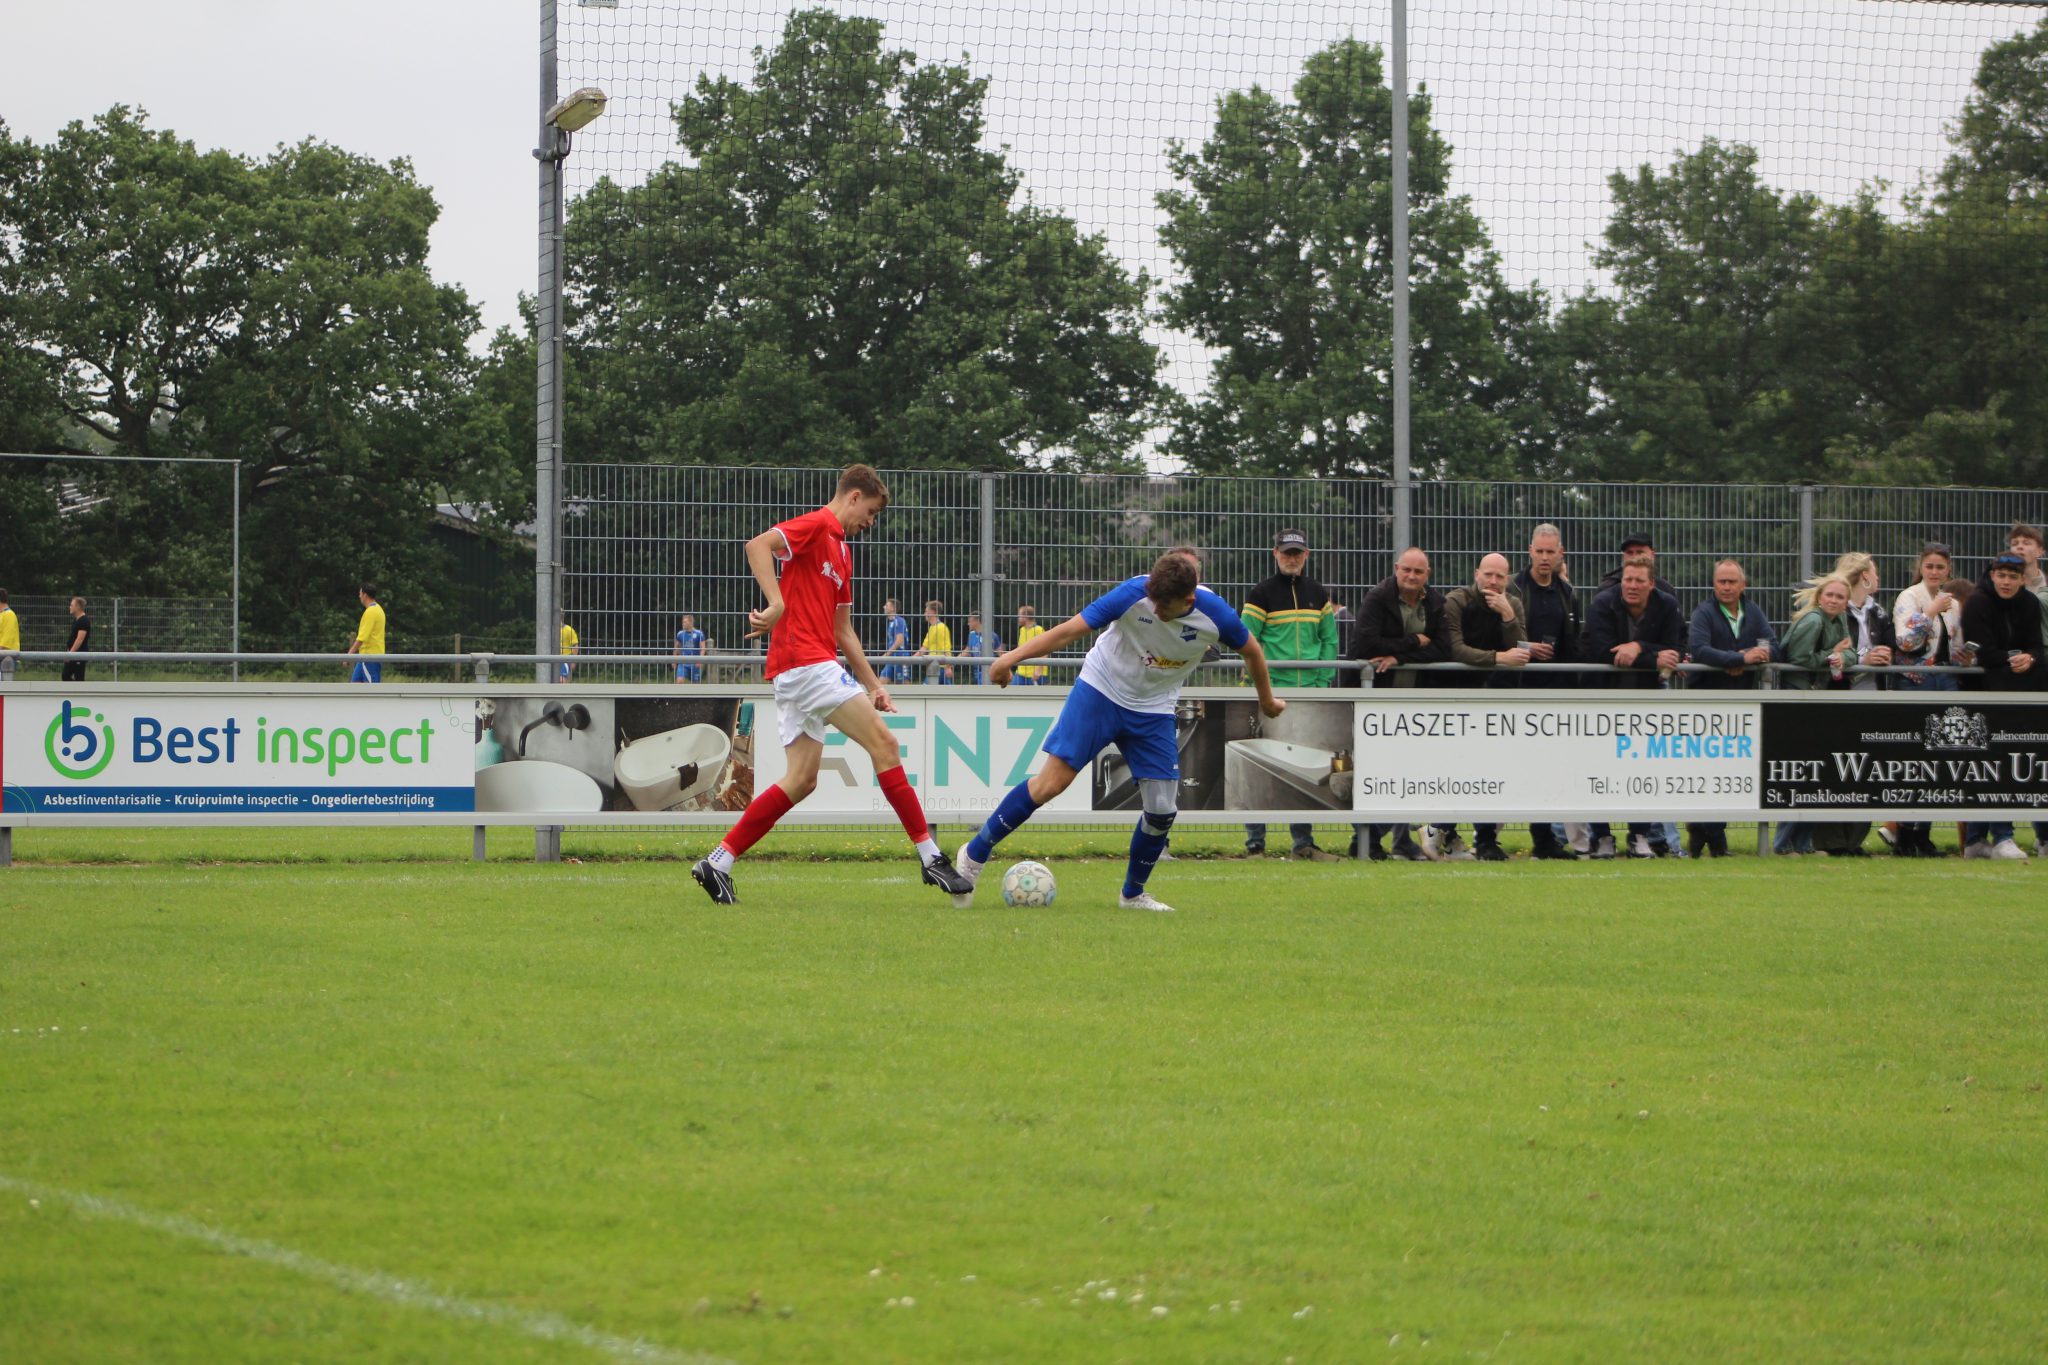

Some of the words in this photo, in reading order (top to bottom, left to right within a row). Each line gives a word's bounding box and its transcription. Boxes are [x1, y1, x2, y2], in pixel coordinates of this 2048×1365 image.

[1362, 713, 1478, 737] GLASZET-
[1485, 713, 1516, 737] EN
[1524, 713, 1753, 739] SCHILDERSBEDRIJF
[1861, 731, 1912, 740] restaurant
[132, 717, 241, 764] Best
[257, 716, 435, 777] inspect
[1616, 735, 1639, 759] P.
[1646, 735, 1753, 759] MENGER
[1767, 760, 1825, 782] HET
[1831, 752, 1939, 782] WAPEN
[1946, 760, 2001, 782] VAN
[1363, 777, 1396, 795] Sint
[1400, 776, 1505, 799] Jansklooster
[1587, 776, 1620, 794] Tel.:
[1626, 776, 1659, 797] (06)
[1665, 776, 1706, 794] 5212
[1712, 776, 1753, 794] 3338
[1766, 788, 1785, 803] St.
[1788, 788, 1870, 807] Jansklooster
[1882, 788, 1913, 803] 0527
[1917, 788, 1964, 803] 246454
[43, 793, 162, 806] Asbestinventarisatie
[174, 794, 244, 808] Kruipruimte
[247, 793, 299, 808] inspectie
[311, 793, 435, 808] Ongediertebestrijding
[872, 797, 961, 811] BAOOM
